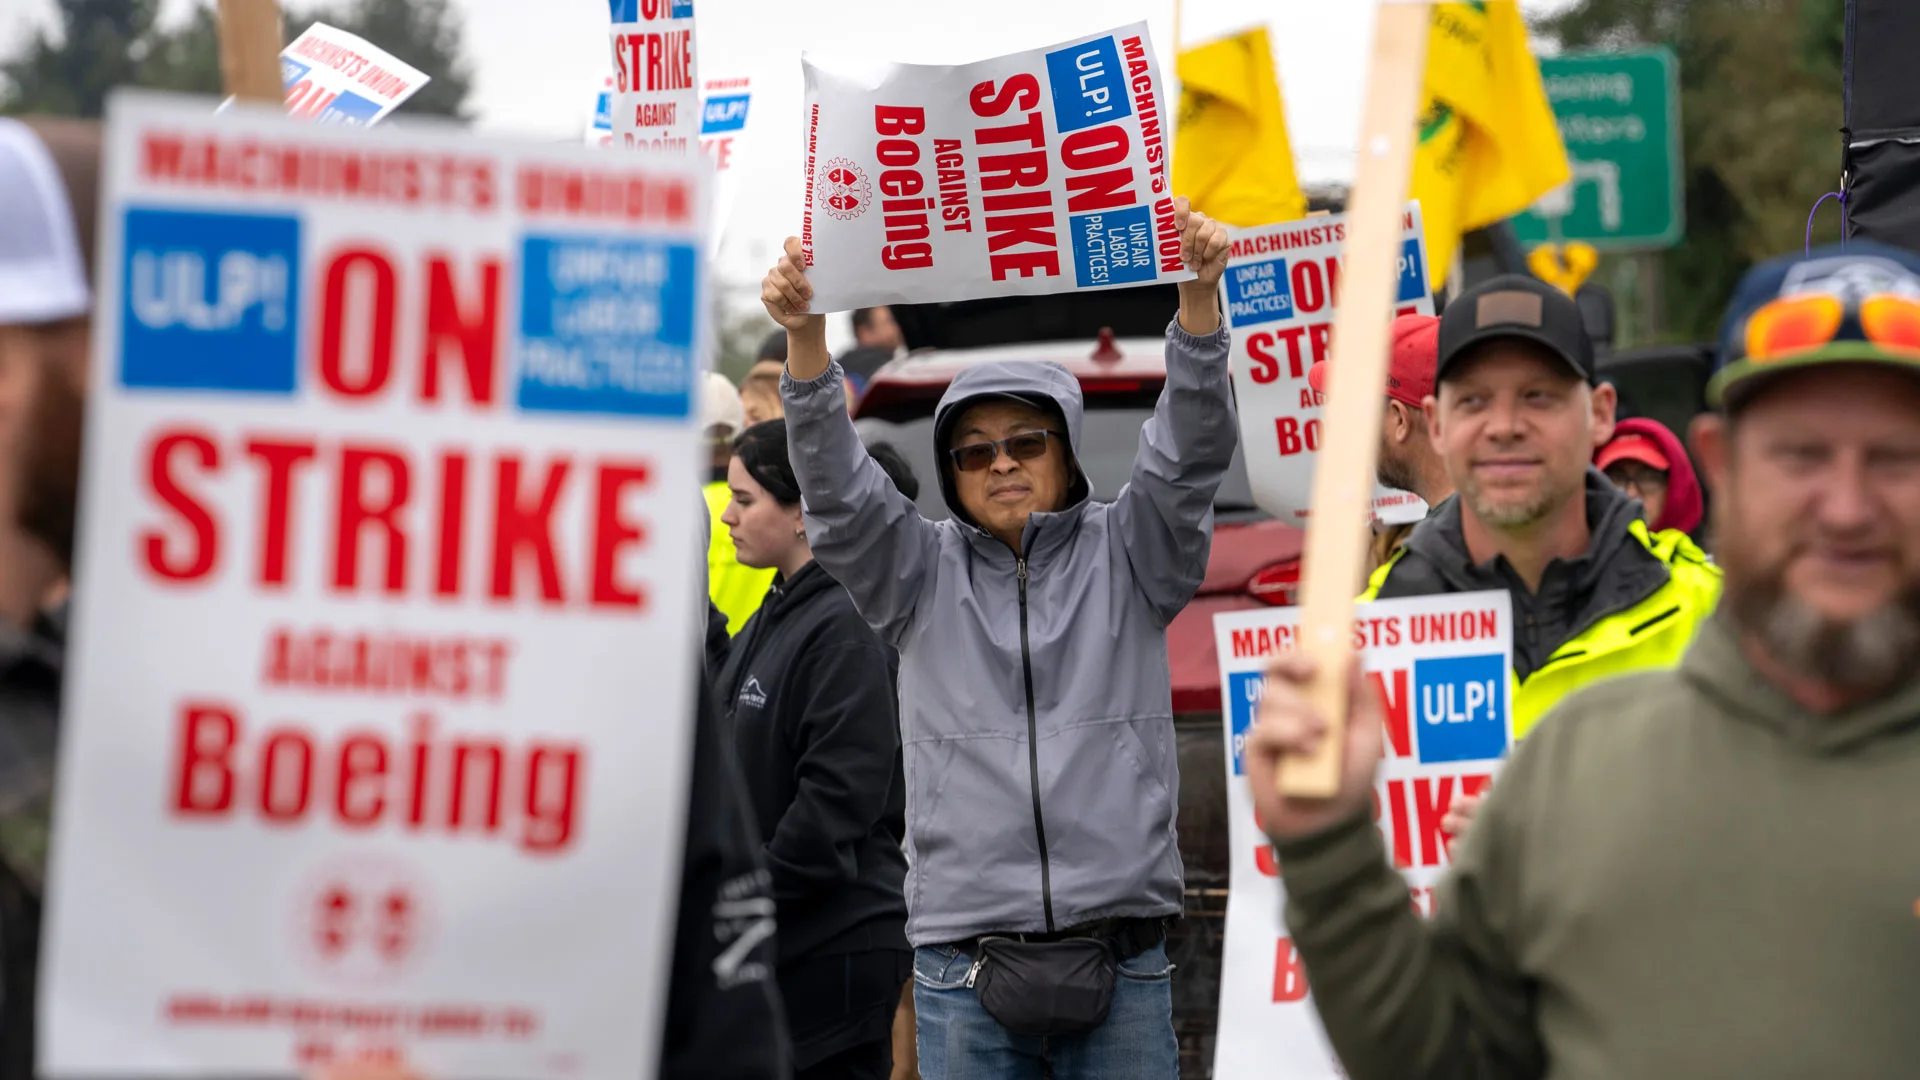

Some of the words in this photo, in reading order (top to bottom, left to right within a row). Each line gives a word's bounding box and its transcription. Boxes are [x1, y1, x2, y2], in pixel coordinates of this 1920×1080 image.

[358, 65, 410, 100] UNION
[615, 30, 693, 93] STRIKE
[1076, 49, 1113, 117] ULP!
[635, 102, 677, 127] AGAINST
[144, 137, 493, 208] MACHINISTS
[516, 168, 690, 223] UNION
[804, 156, 816, 210] DISTRICT
[933, 139, 972, 233] AGAINST
[969, 73, 1060, 281] STRIKE
[1060, 125, 1137, 213] ON
[1122, 36, 1167, 194] MACHINISTS
[1154, 197, 1185, 273] UNION
[875, 104, 936, 271] Boeing
[802, 211, 812, 246] LODGE
[1084, 215, 1109, 285] PRACTICES!
[1108, 227, 1129, 268] LABOR
[1129, 222, 1150, 268] UNFAIR
[1227, 223, 1346, 260] MACHINISTS
[131, 249, 289, 331] ULP!
[1235, 263, 1276, 284] UNFAIR
[1239, 279, 1276, 300] LABOR
[313, 242, 507, 410] ON
[1230, 294, 1292, 318] PRACTICES!
[138, 426, 653, 614] STRIKE
[1409, 609, 1498, 645] UNION
[265, 631, 507, 697] AGAINST
[1422, 680, 1496, 726] ULP!
[171, 701, 584, 854] Boeing
